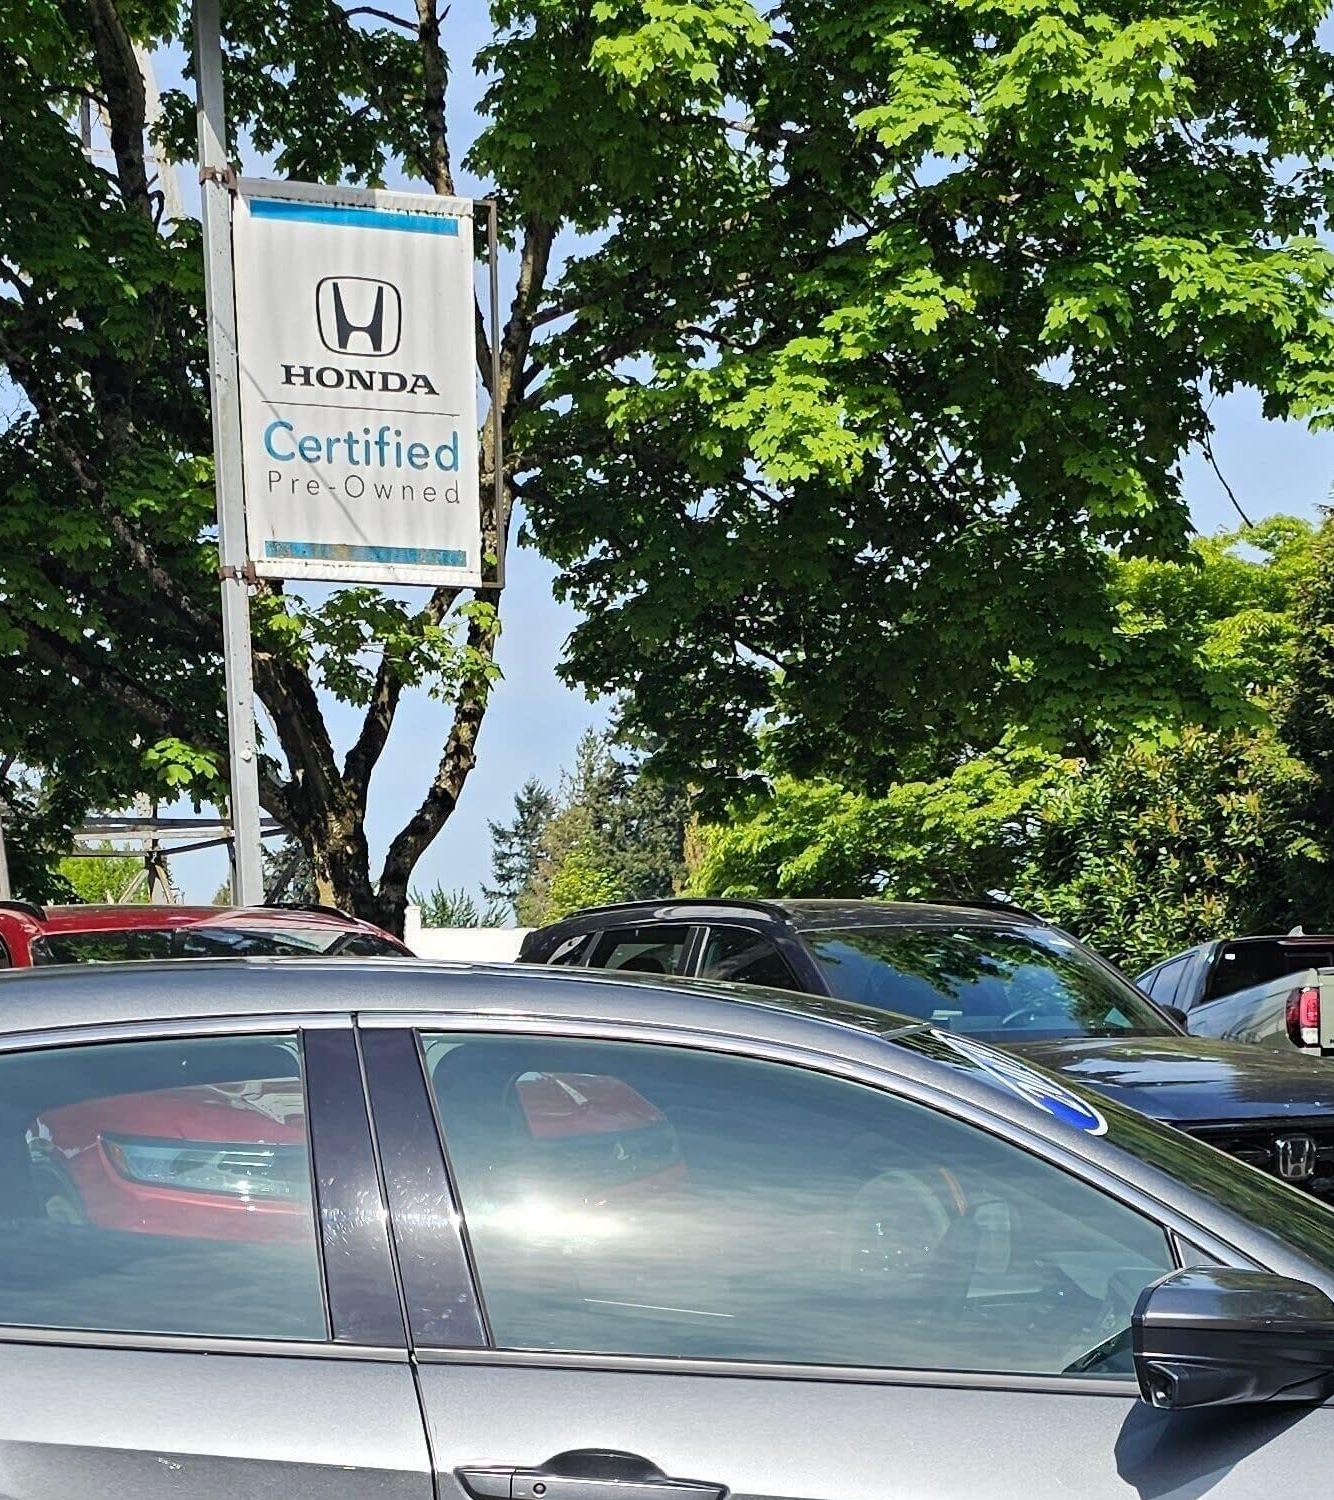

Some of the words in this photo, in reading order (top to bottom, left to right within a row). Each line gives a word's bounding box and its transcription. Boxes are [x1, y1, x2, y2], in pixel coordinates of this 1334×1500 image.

[280, 364, 440, 396] HONDA
[263, 420, 460, 473] Certified
[267, 469, 461, 505] Pre-Owned
